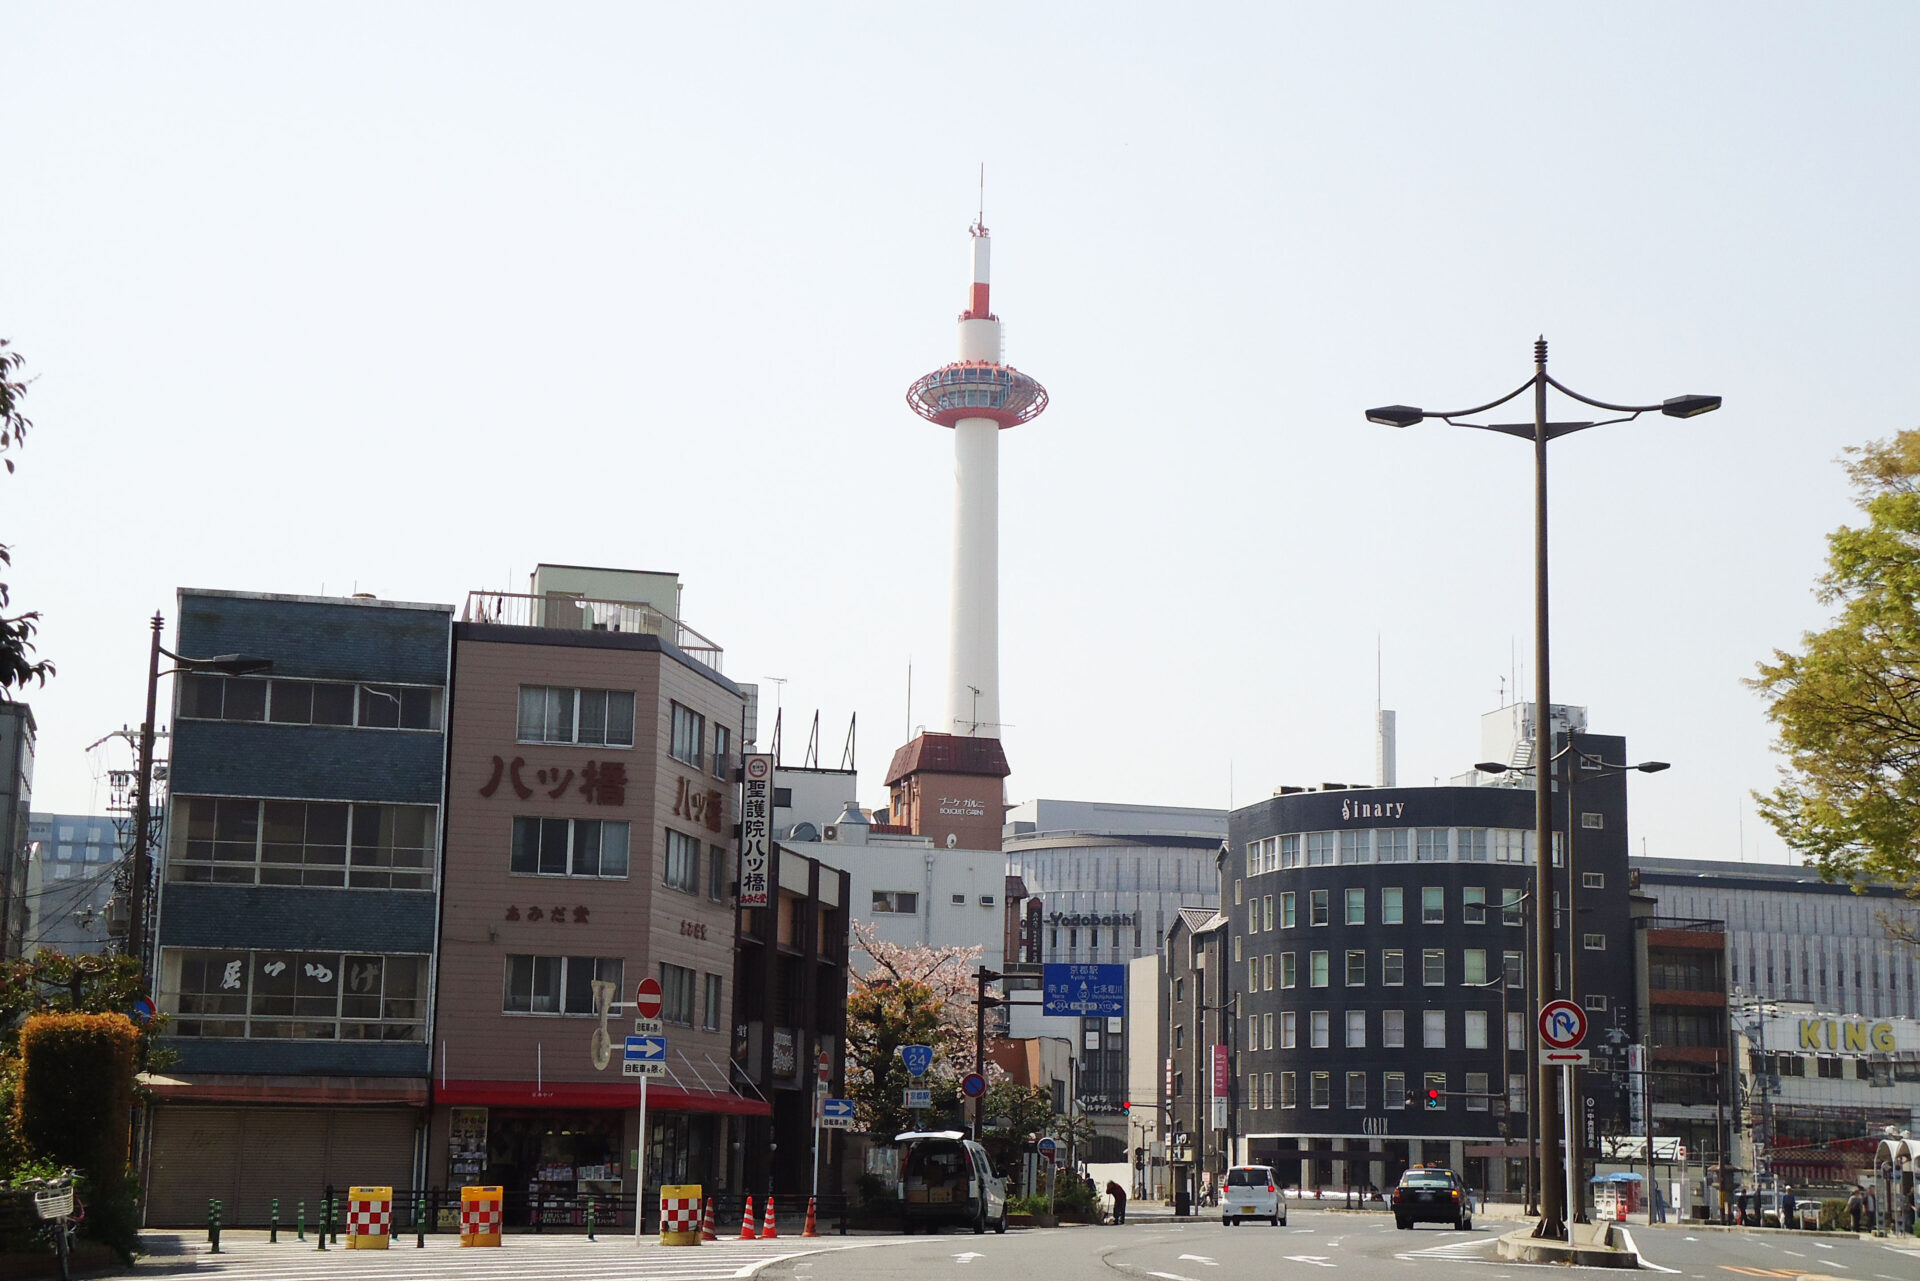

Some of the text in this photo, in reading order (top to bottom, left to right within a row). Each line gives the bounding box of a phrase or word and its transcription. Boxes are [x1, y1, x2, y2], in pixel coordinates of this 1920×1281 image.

[1342, 798, 1405, 821] Sinary
[1070, 966, 1098, 974] 京都駅
[1799, 1019, 1895, 1051] KING
[909, 1054, 926, 1066] 24
[625, 1064, 663, 1074] 自転車を除く
